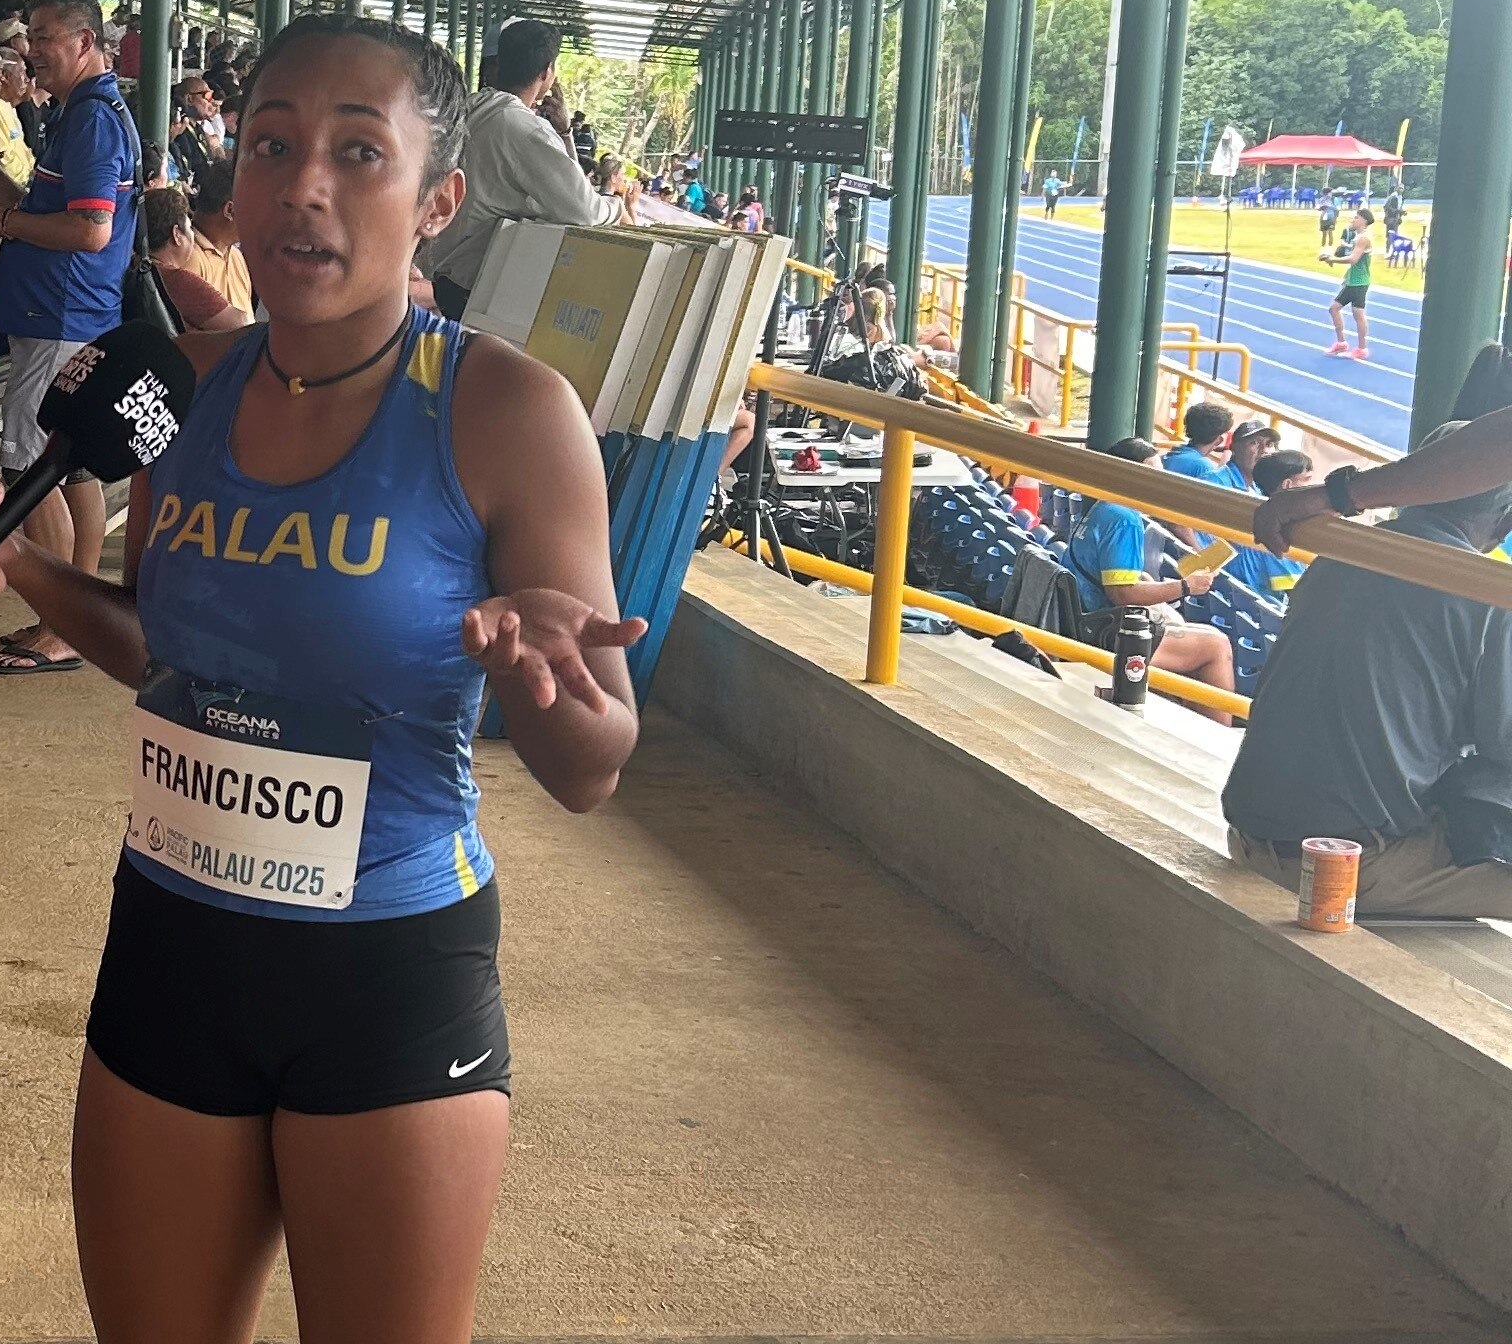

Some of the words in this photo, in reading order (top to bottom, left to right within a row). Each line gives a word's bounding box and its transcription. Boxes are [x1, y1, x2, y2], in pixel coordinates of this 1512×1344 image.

[127, 379, 180, 442] PACIFIC
[140, 369, 169, 398] THAT
[114, 395, 168, 458] SPORTS
[128, 435, 155, 466] SHOW
[147, 493, 390, 576] PALAU
[205, 719, 280, 740] ATHLETICS
[206, 707, 280, 733] OCEANIA
[141, 737, 344, 829] FRANCISCO
[191, 839, 255, 886] PALAU
[260, 859, 326, 897] 2025
